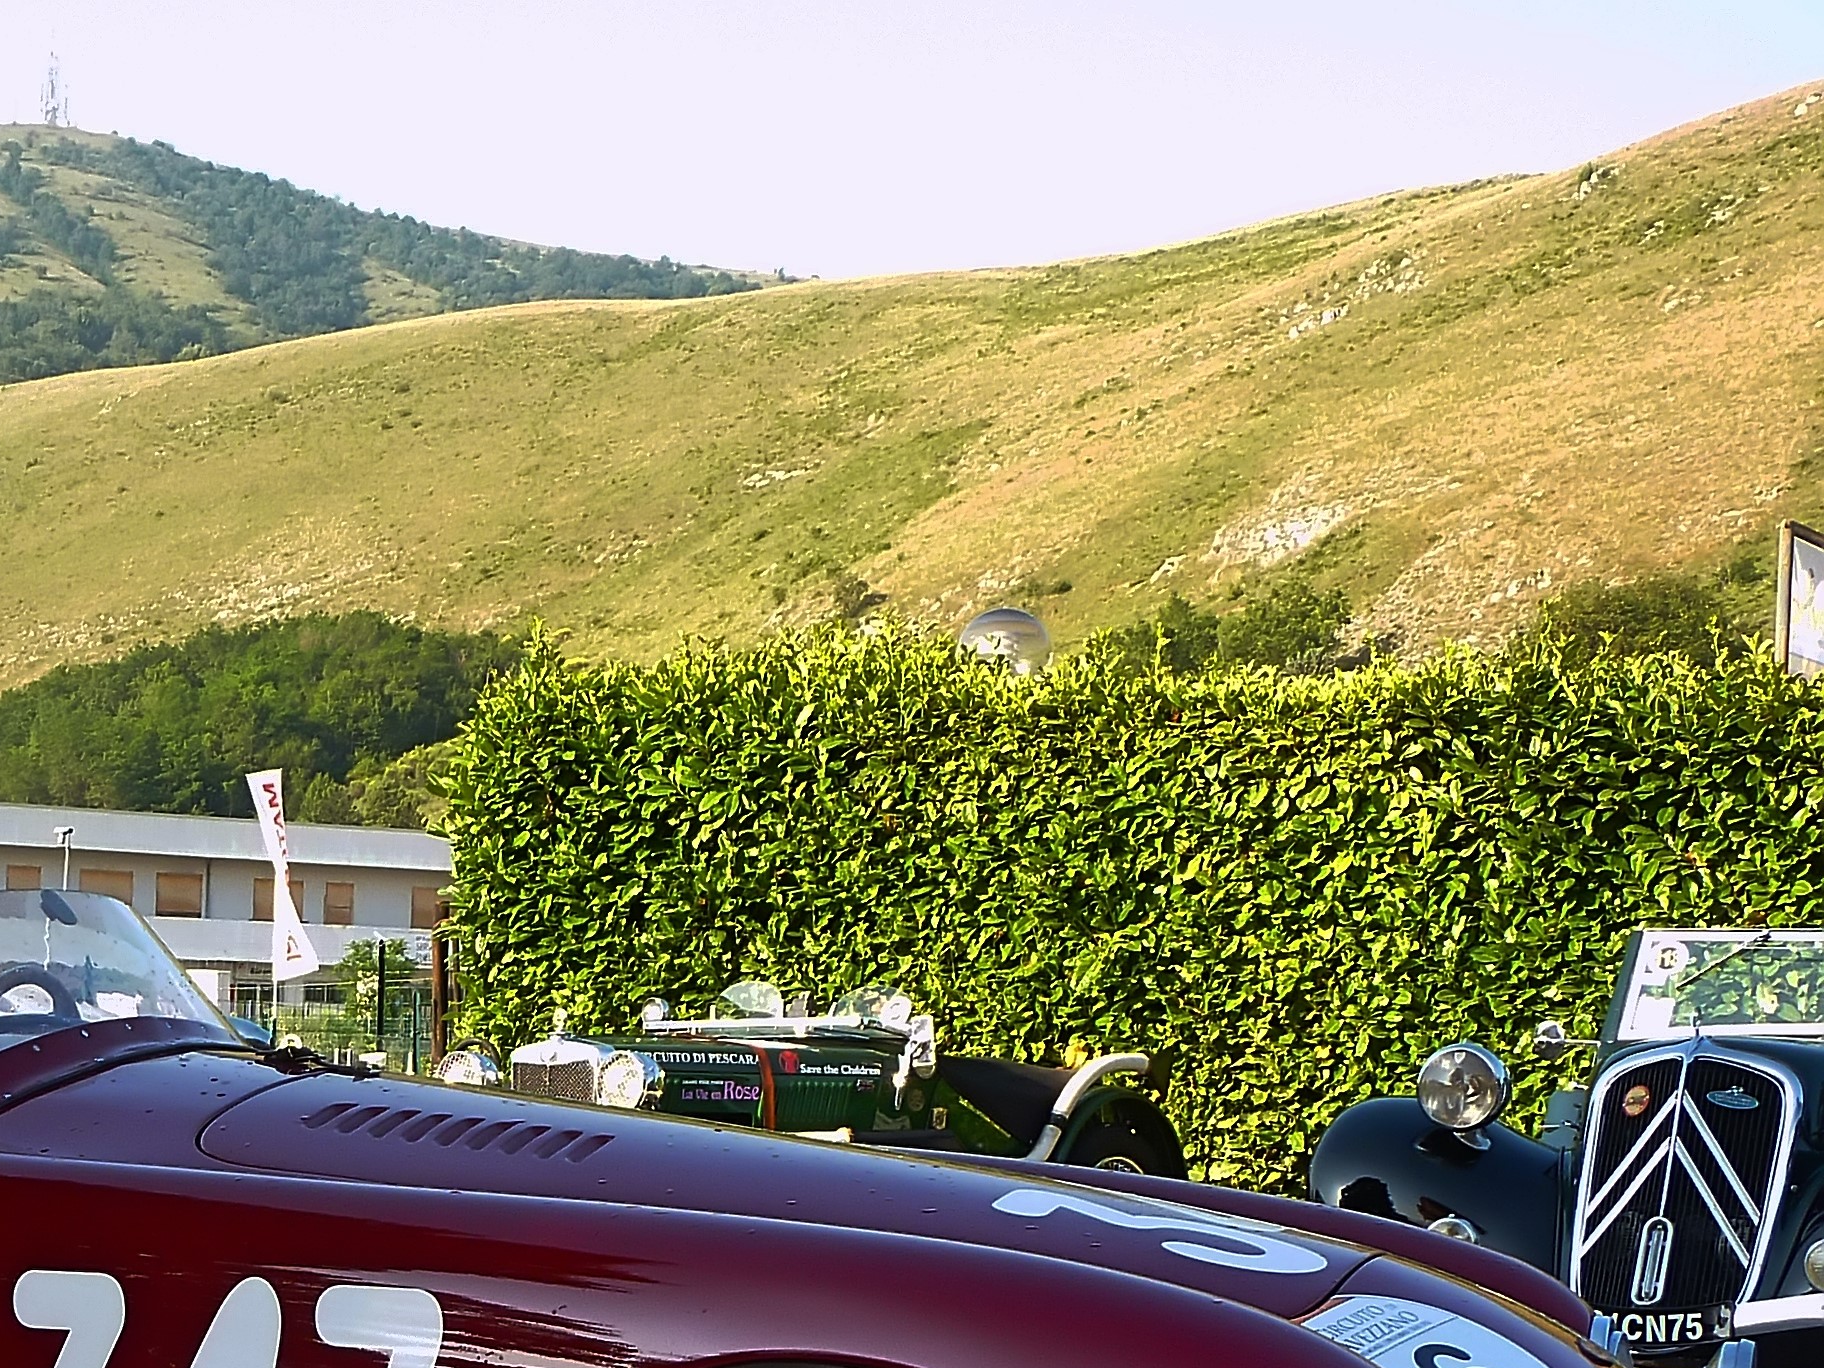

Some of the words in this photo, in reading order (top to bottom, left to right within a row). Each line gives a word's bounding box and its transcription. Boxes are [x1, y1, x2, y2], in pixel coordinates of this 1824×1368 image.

[693, 1052, 706, 1064] DI
[800, 1064, 824, 1075] Save
[825, 1065, 839, 1075] the
[841, 1063, 881, 1076] Children
[723, 1080, 760, 1101] Rose
